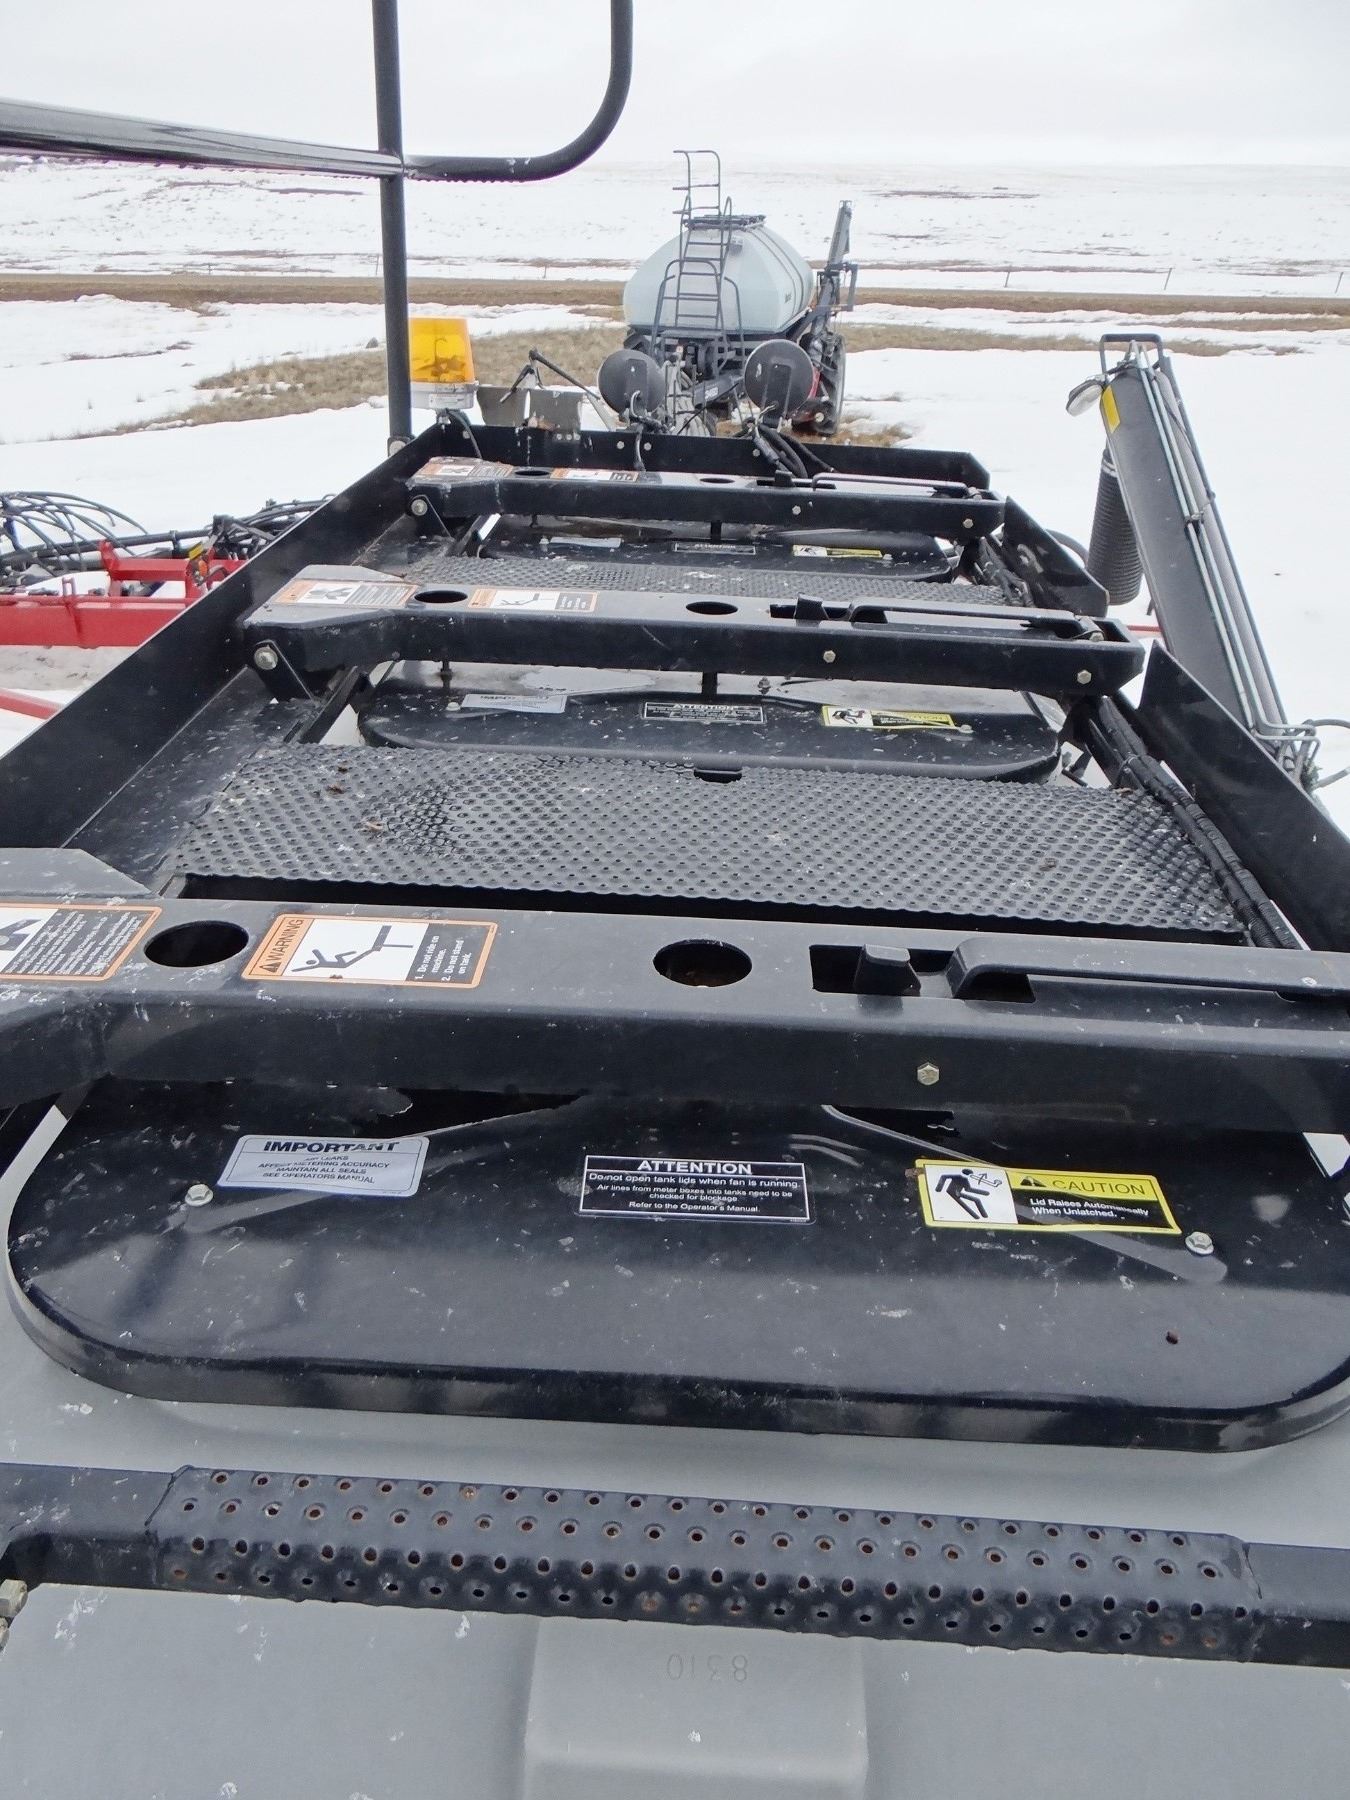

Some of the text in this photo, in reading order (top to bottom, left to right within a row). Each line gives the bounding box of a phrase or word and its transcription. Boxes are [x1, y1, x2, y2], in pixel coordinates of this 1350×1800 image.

[266, 919, 304, 961] WARNING
[417, 964, 429, 973] Do
[423, 954, 433, 964] not
[444, 964, 455, 974] Do
[263, 1141, 400, 1153] IMPORTANT
[637, 1160, 753, 1175] ATTENTION
[337, 1175, 376, 1184] MANUAL
[625, 1175, 651, 1183] open
[653, 1176, 676, 1184] tank
[699, 1178, 727, 1186] when
[729, 1178, 746, 1186] fan
[1052, 1180, 1145, 1195] CAUTION
[680, 1203, 725, 1211] Operators
[1030, 1198, 1149, 1216] Lid Raises Automatically
[1031, 1207, 1118, 1217] When Unlatched.
